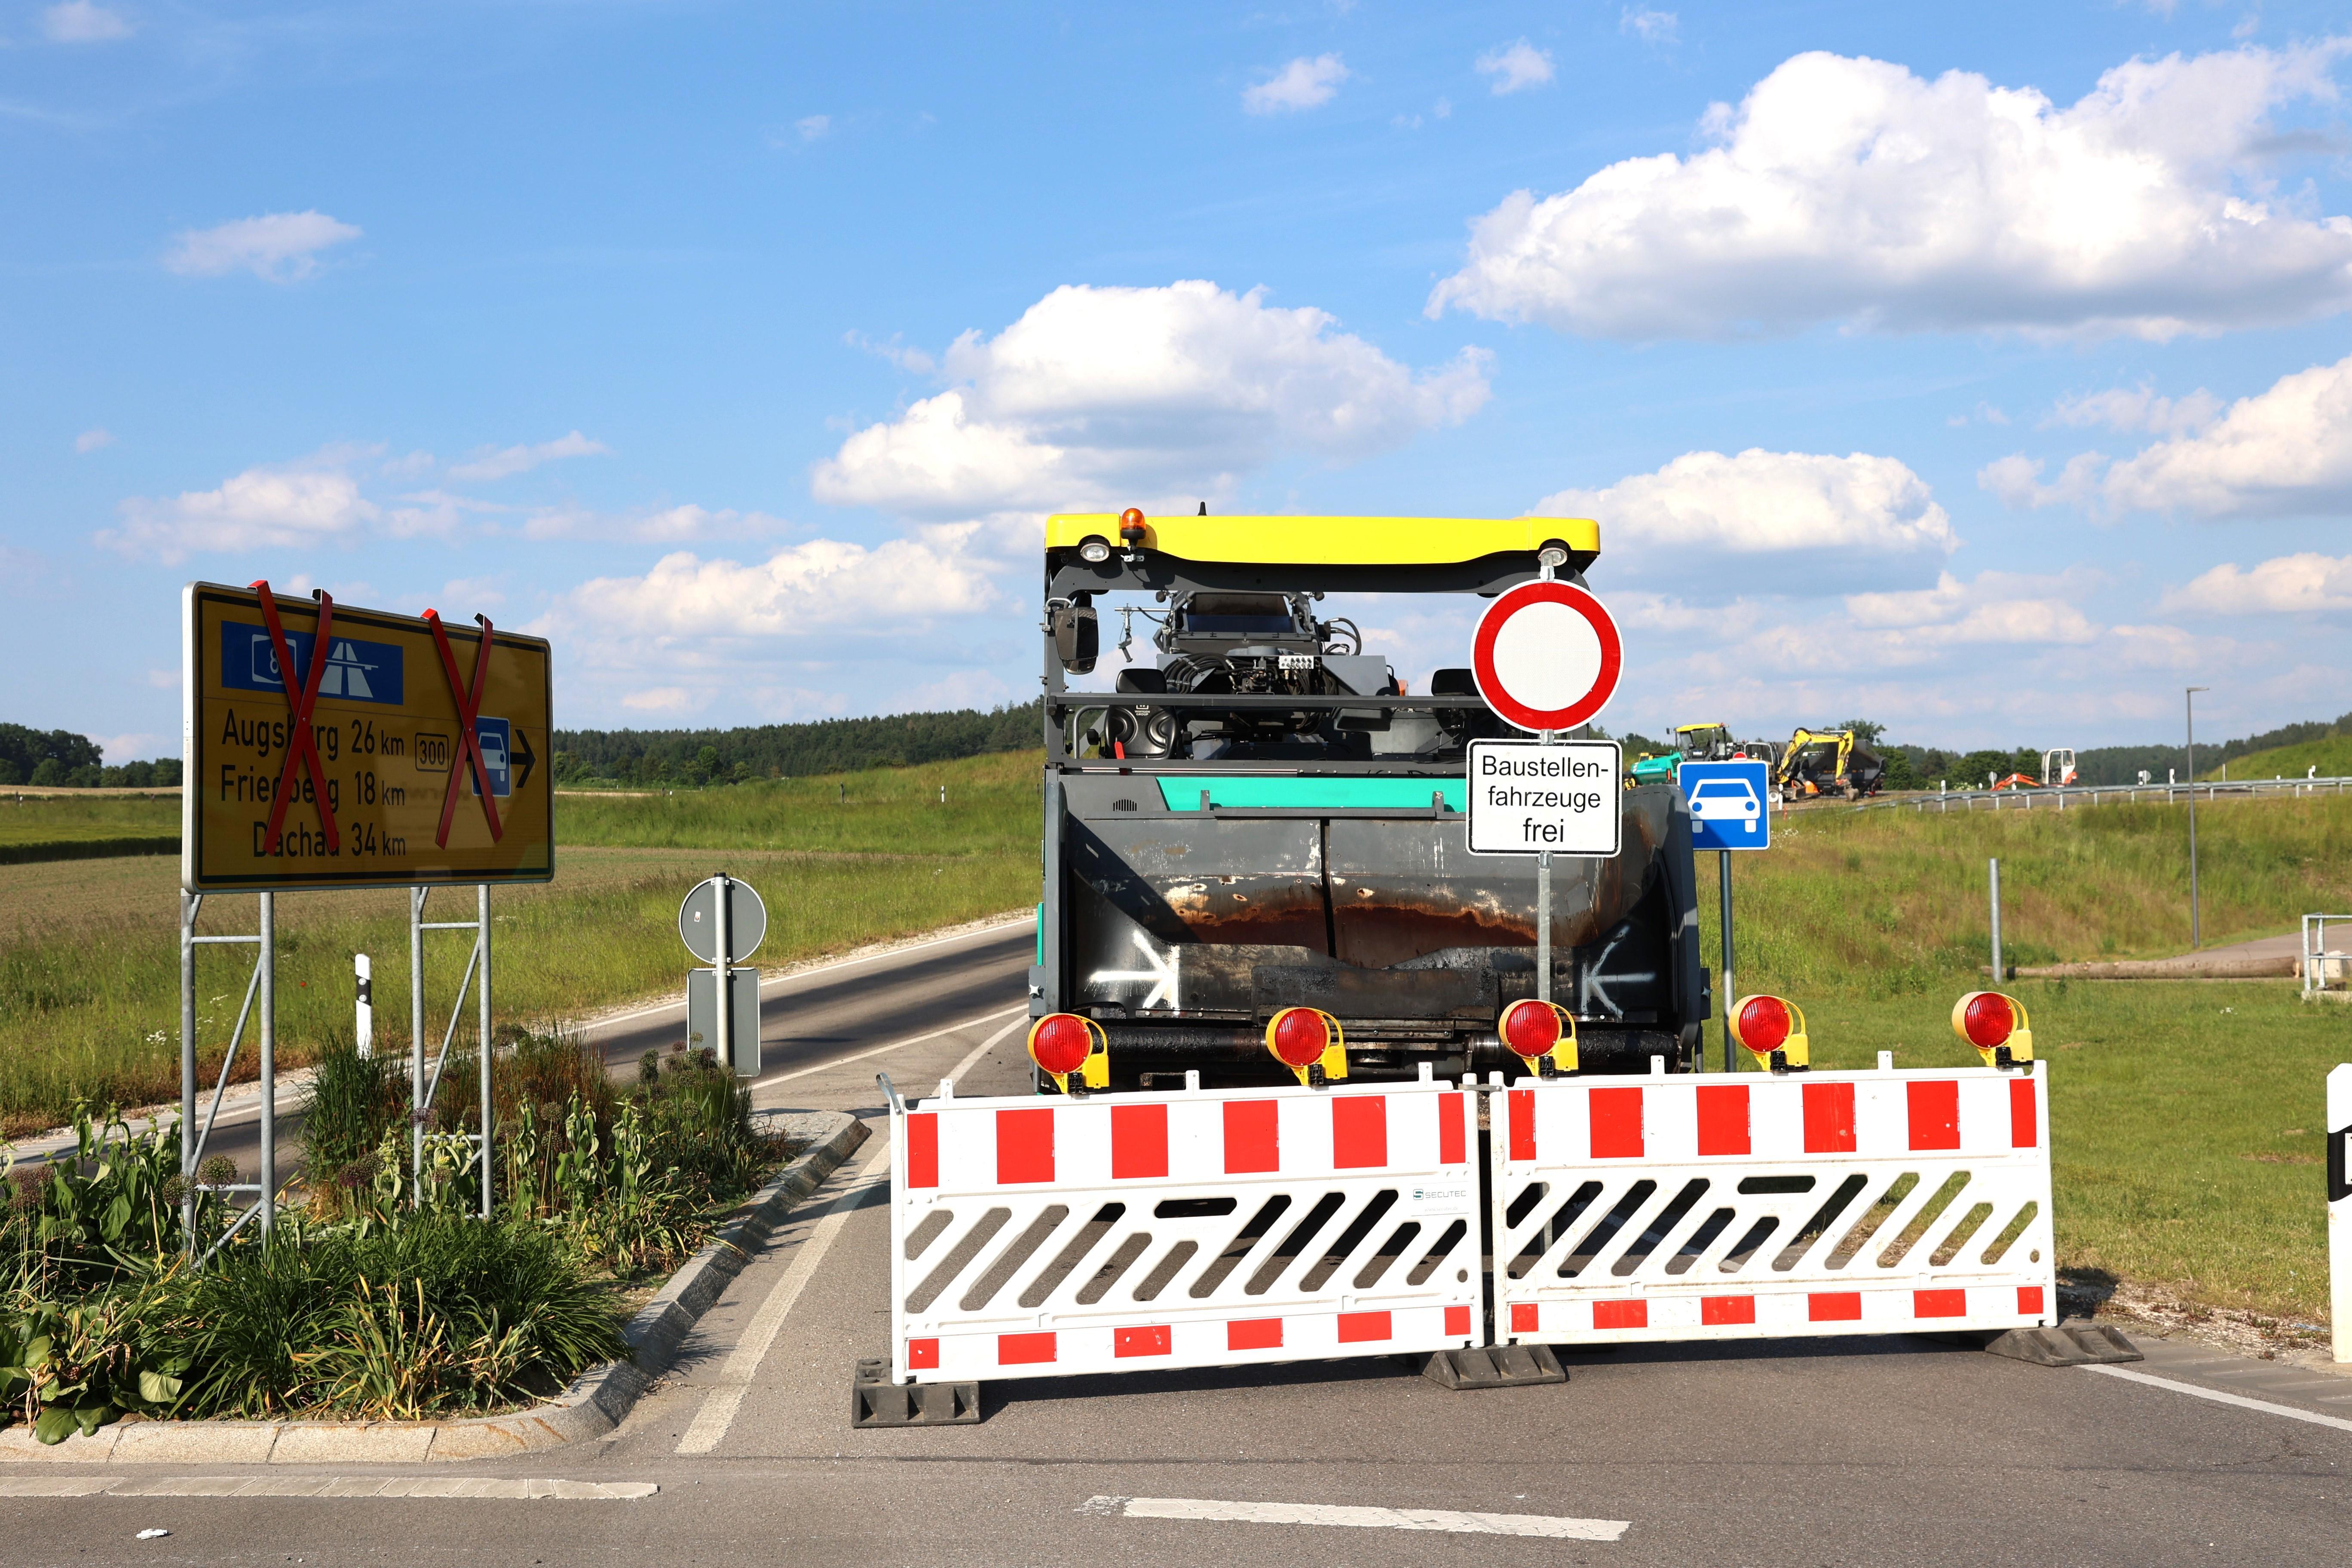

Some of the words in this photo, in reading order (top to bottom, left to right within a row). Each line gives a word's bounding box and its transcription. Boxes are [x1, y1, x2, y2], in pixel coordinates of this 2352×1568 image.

[270, 646, 279, 674] 8
[222, 708, 339, 761] Augsrg
[351, 719, 375, 754] 26
[381, 730, 404, 756] km
[420, 740, 445, 766] 300
[1482, 755, 1608, 778] Baustellen-
[221, 764, 339, 814] Friebeg
[355, 771, 376, 805] 18
[382, 780, 405, 806] km
[1488, 785, 1601, 813] fahrzeuge
[351, 822, 377, 857] 34
[382, 830, 406, 856] km
[1523, 818, 1564, 842] frei
[1425, 1190, 1467, 1198] SECUTEC
